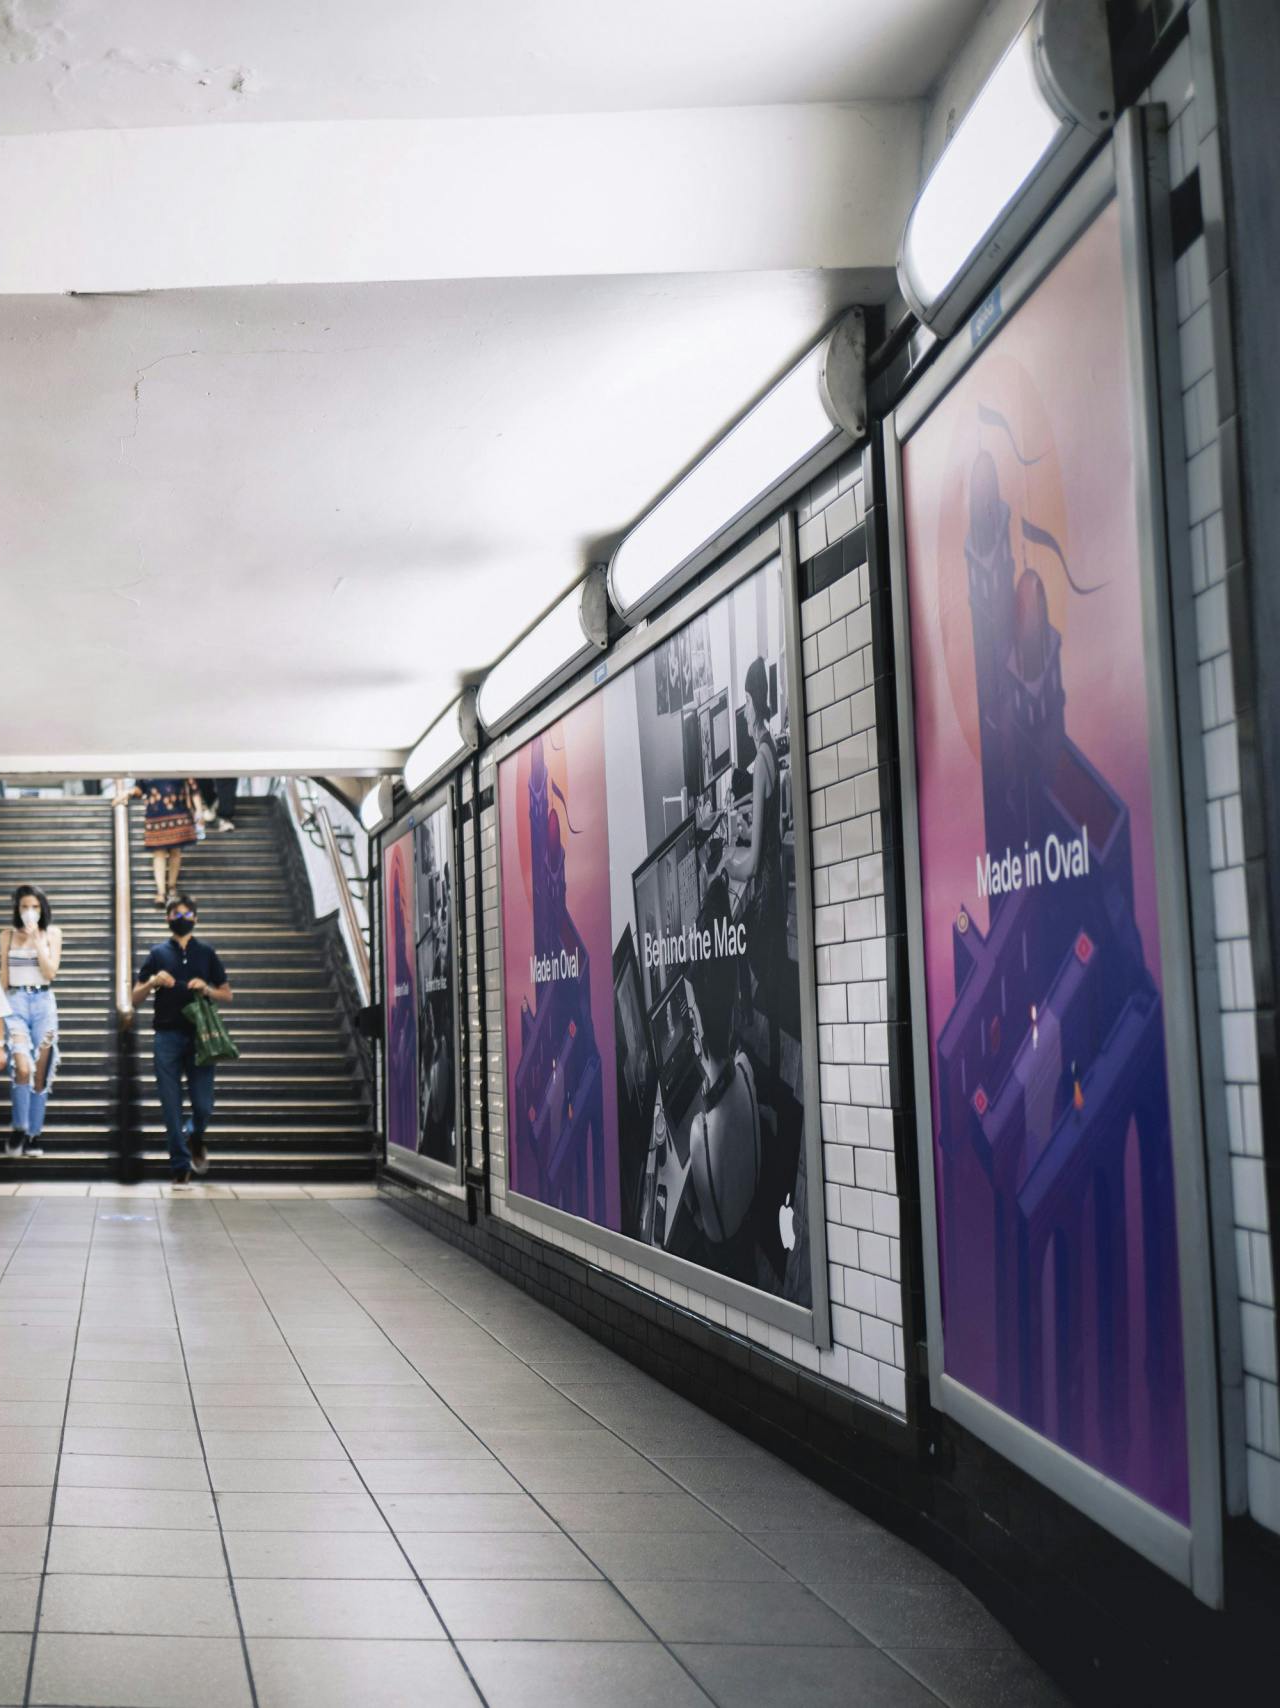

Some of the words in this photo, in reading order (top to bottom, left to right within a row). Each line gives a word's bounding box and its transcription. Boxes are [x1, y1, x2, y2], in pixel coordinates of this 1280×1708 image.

[976, 847, 1022, 898] Made
[1024, 840, 1042, 887] in
[1045, 824, 1089, 882] Oval
[530, 953, 551, 984] Made
[551, 951, 560, 980] in
[560, 946, 579, 980] Oval
[644, 924, 686, 968] Behind
[688, 922, 711, 962] the
[713, 916, 747, 958] Mac
